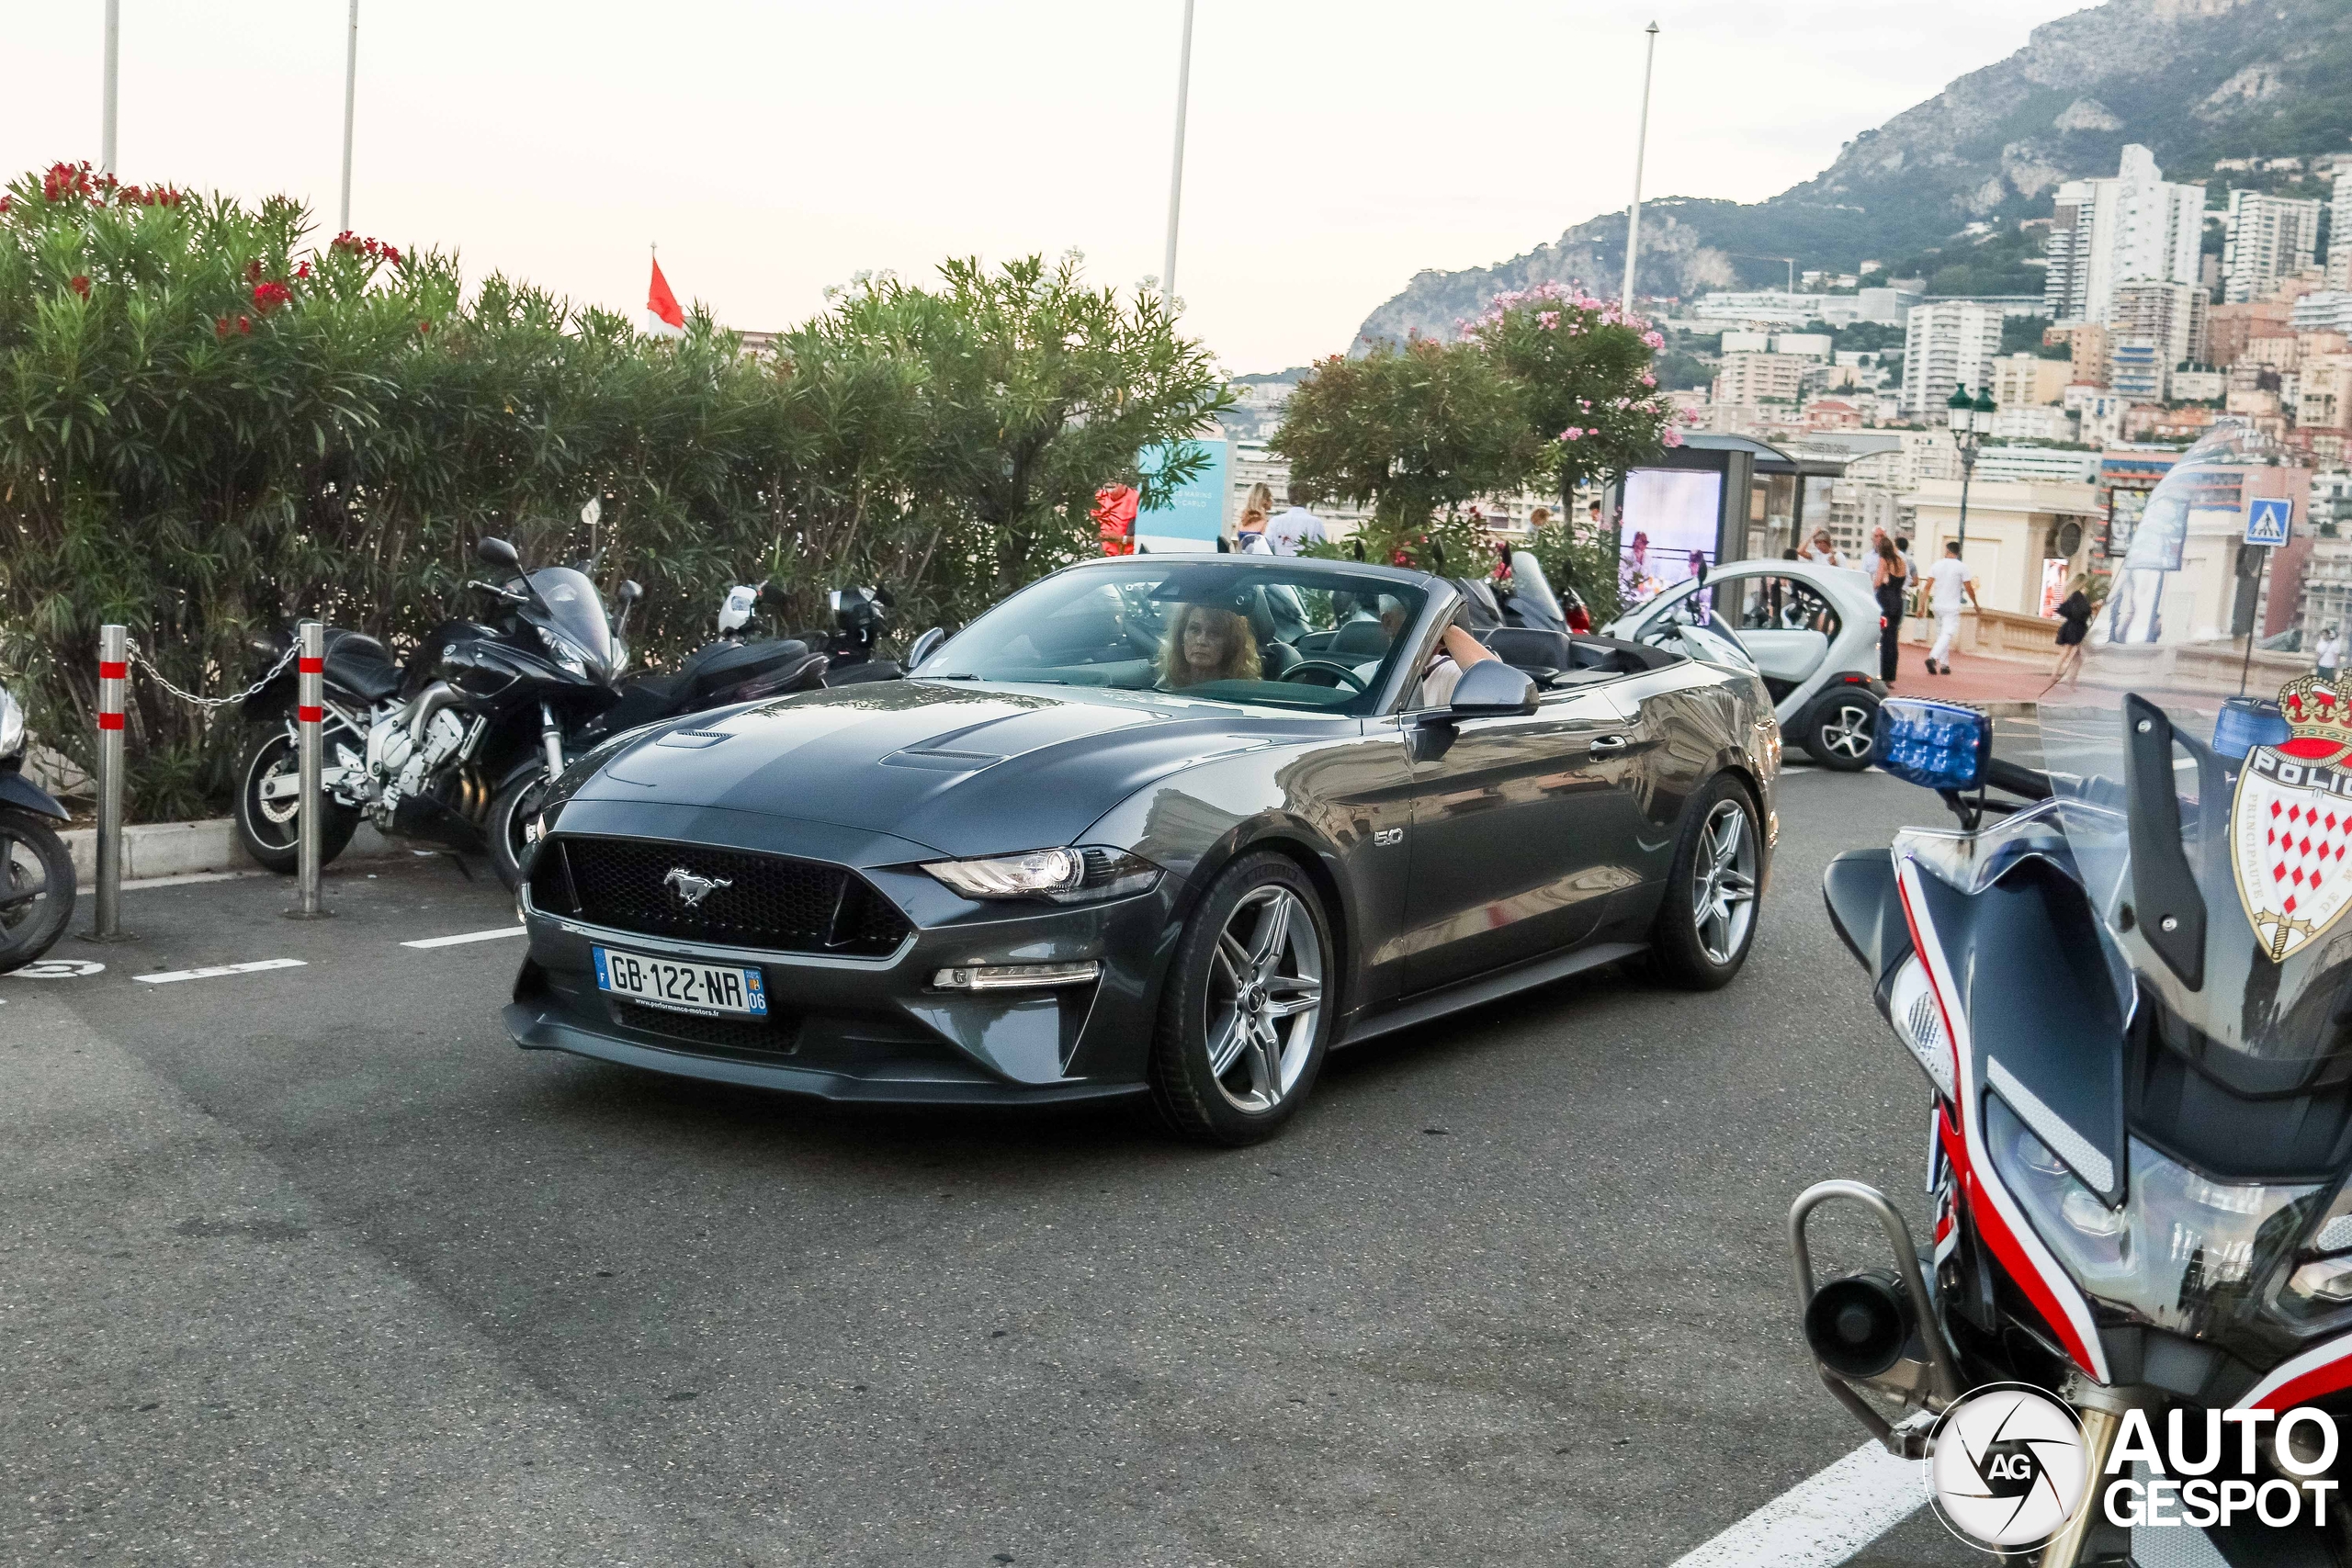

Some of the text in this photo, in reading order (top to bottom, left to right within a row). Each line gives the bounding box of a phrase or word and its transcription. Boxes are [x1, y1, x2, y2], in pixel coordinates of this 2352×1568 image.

[2320, 892, 2339, 913] DE
[600, 973, 605, 983] F
[611, 955, 743, 1008] GB-122-NR
[635, 998, 719, 1017] www.performance-motors.fr
[749, 992, 766, 1010] 06
